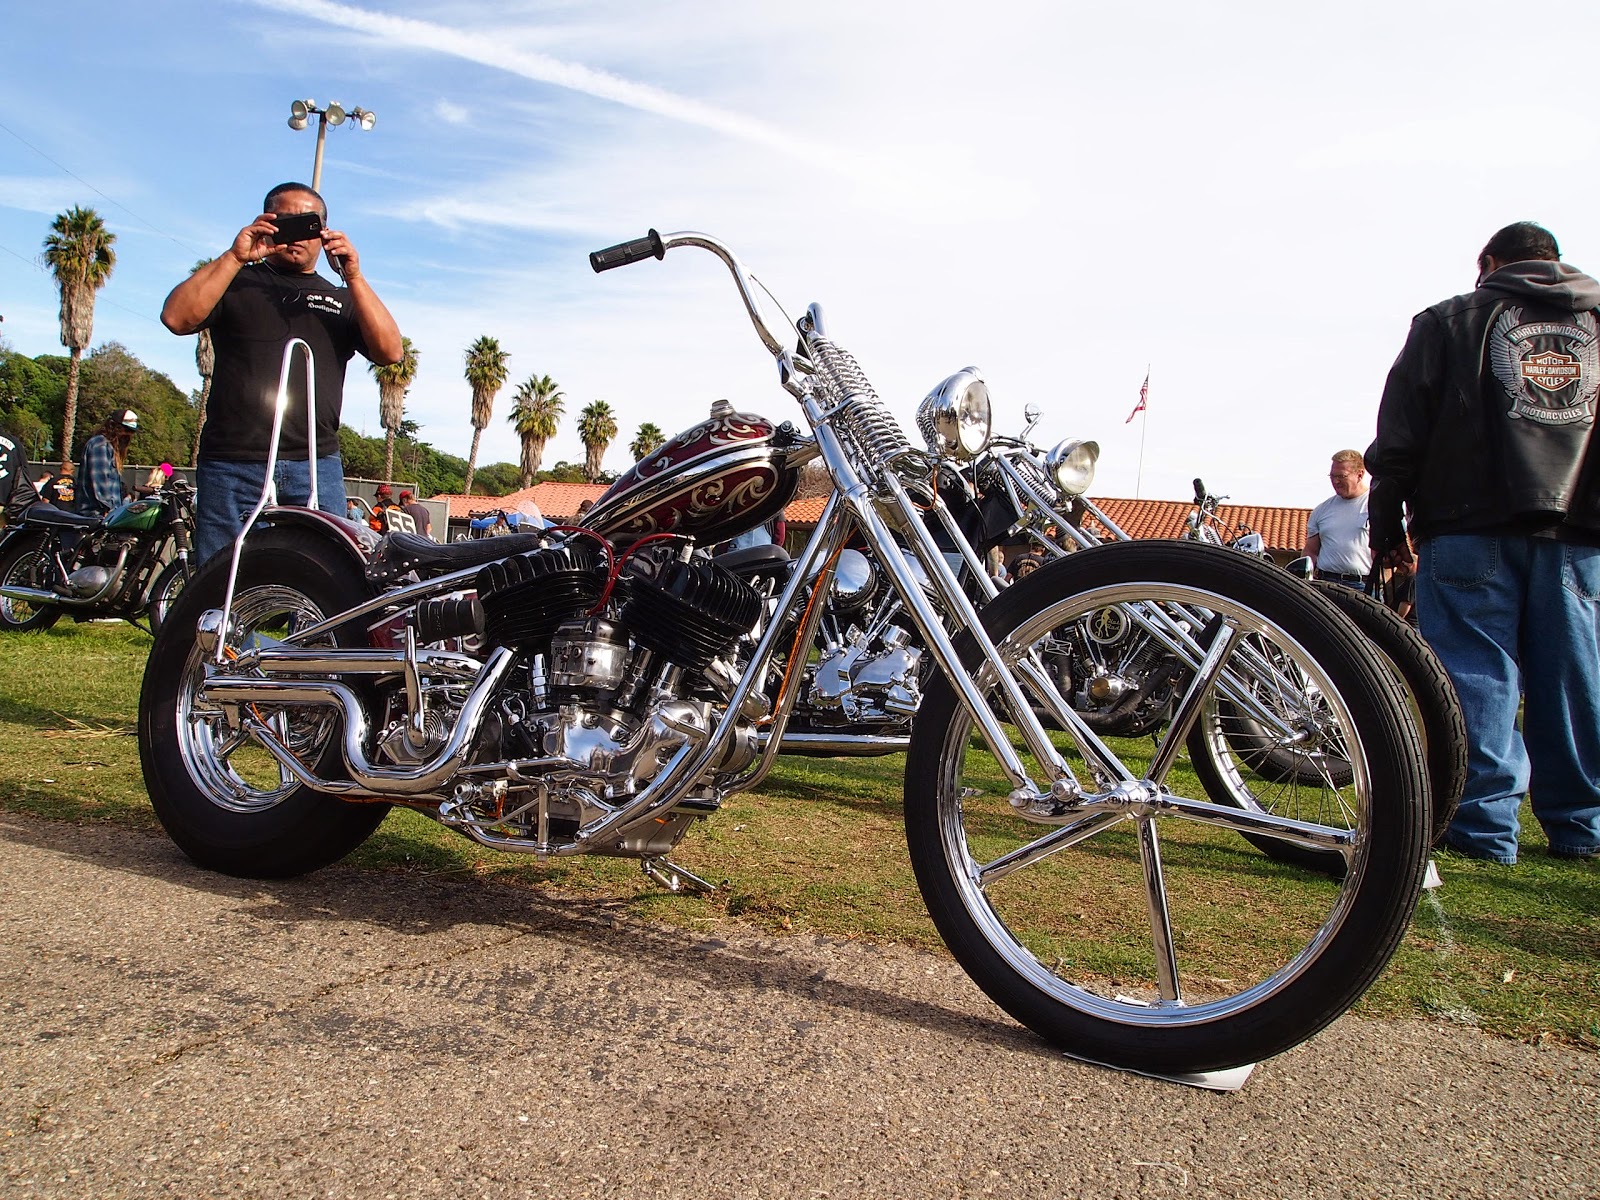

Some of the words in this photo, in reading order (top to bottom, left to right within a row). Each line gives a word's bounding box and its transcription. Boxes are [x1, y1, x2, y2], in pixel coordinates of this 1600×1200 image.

[1510, 325, 1591, 341] HARLEY-DAVIDSON
[1536, 356, 1564, 365] MOTOR
[1525, 366, 1577, 375] HARLEY-DAVIDSON
[1537, 377, 1565, 386] CYCLES
[1520, 405, 1583, 420] MOTORCYCLES
